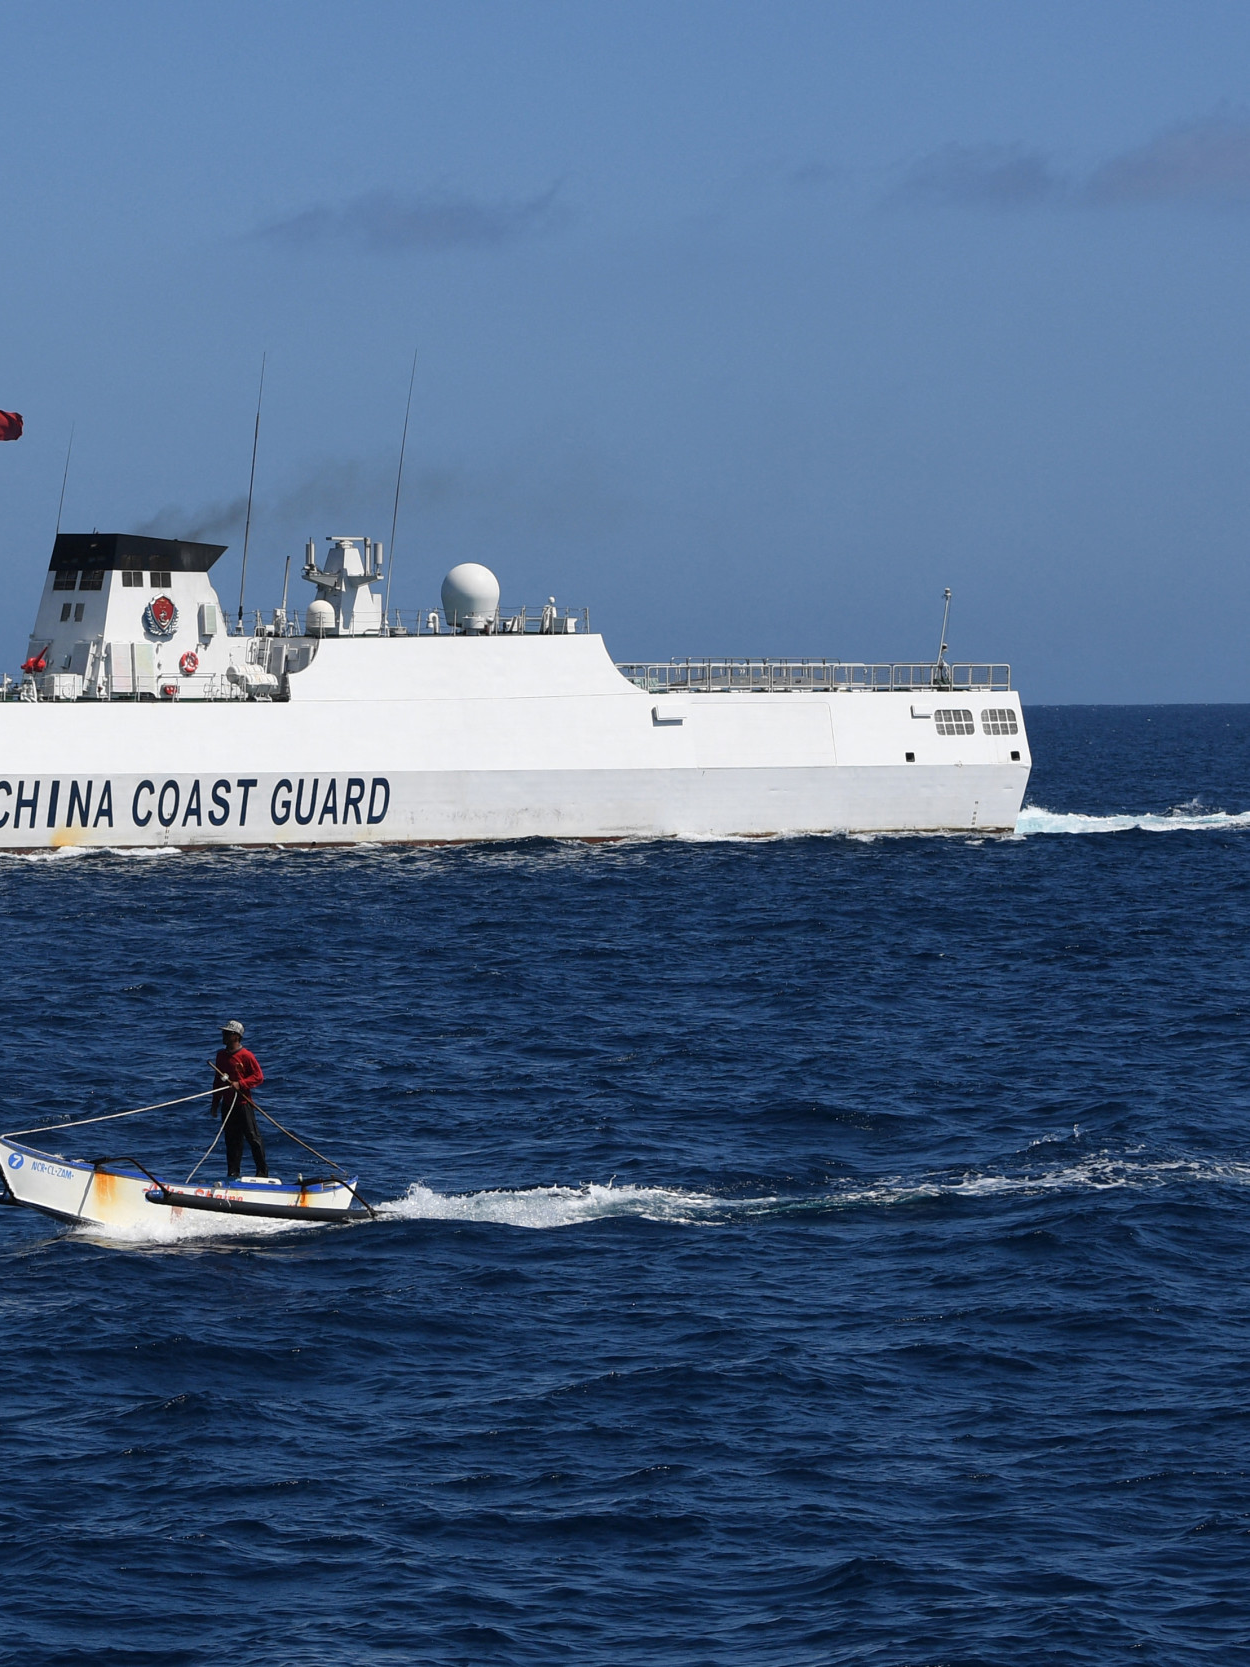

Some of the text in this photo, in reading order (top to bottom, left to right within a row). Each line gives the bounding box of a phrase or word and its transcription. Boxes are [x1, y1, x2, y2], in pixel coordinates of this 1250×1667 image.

[132, 778, 258, 827] COAST
[270, 777, 391, 826] GUARD
[11, 1154, 22, 1167] 7
